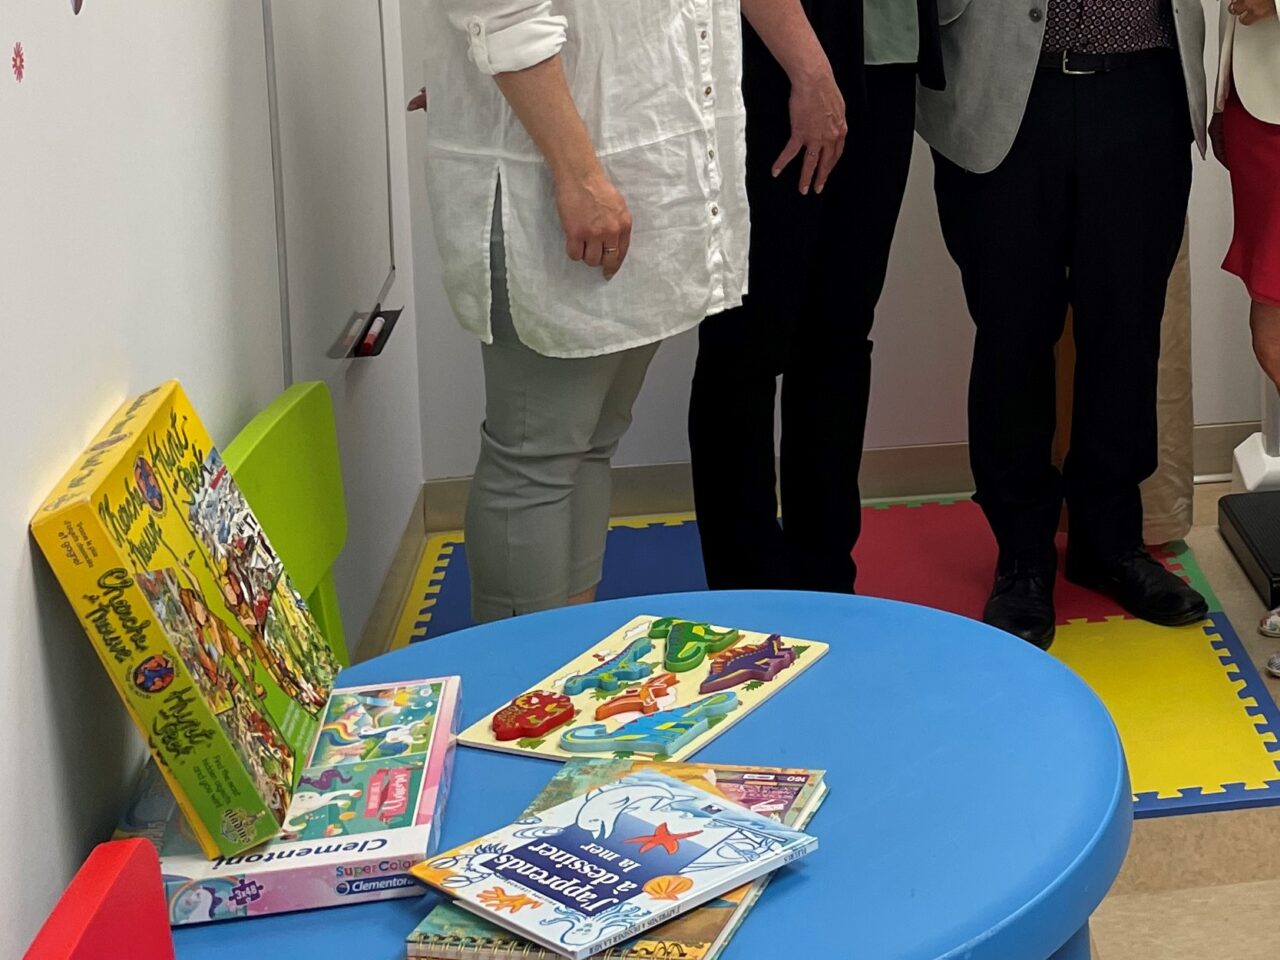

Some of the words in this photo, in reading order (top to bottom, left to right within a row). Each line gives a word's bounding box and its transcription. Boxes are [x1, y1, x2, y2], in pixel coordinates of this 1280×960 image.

[212, 838, 389, 870] Clementoni
[580, 842, 621, 862] mer
[528, 842, 620, 885] dessiner
[618, 858, 641, 873] la
[236, 884, 258, 900] 3x48
[494, 854, 620, 912] J'apprends
[612, 881, 638, 895] à
